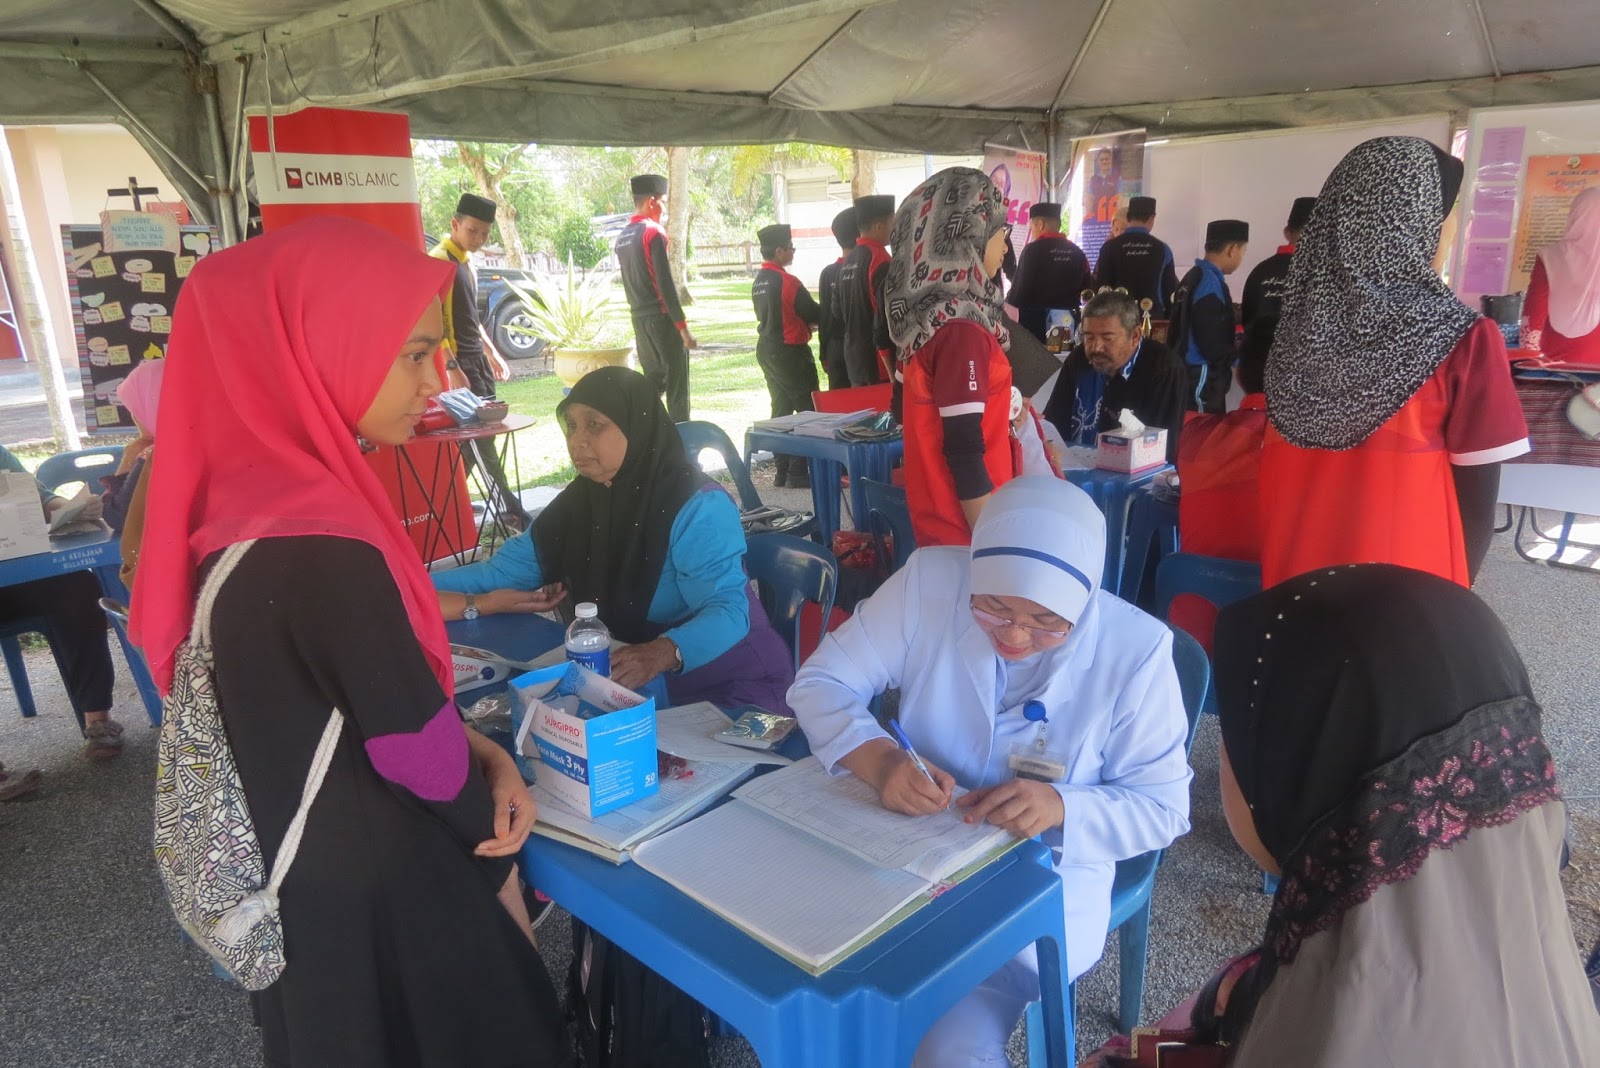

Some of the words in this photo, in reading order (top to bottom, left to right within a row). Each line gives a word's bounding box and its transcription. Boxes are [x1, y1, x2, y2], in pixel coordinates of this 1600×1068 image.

[305, 171, 343, 186] CIMB
[344, 171, 400, 187] ISLAMIC
[544, 715, 580, 737] SURGIPRO
[541, 726, 559, 739] SURGICAL
[559, 734, 584, 749] DISPOSABLE
[549, 750, 566, 766] Mask
[565, 755, 573, 769] 3
[573, 762, 585, 776] Ply
[645, 772, 656, 784] 50
